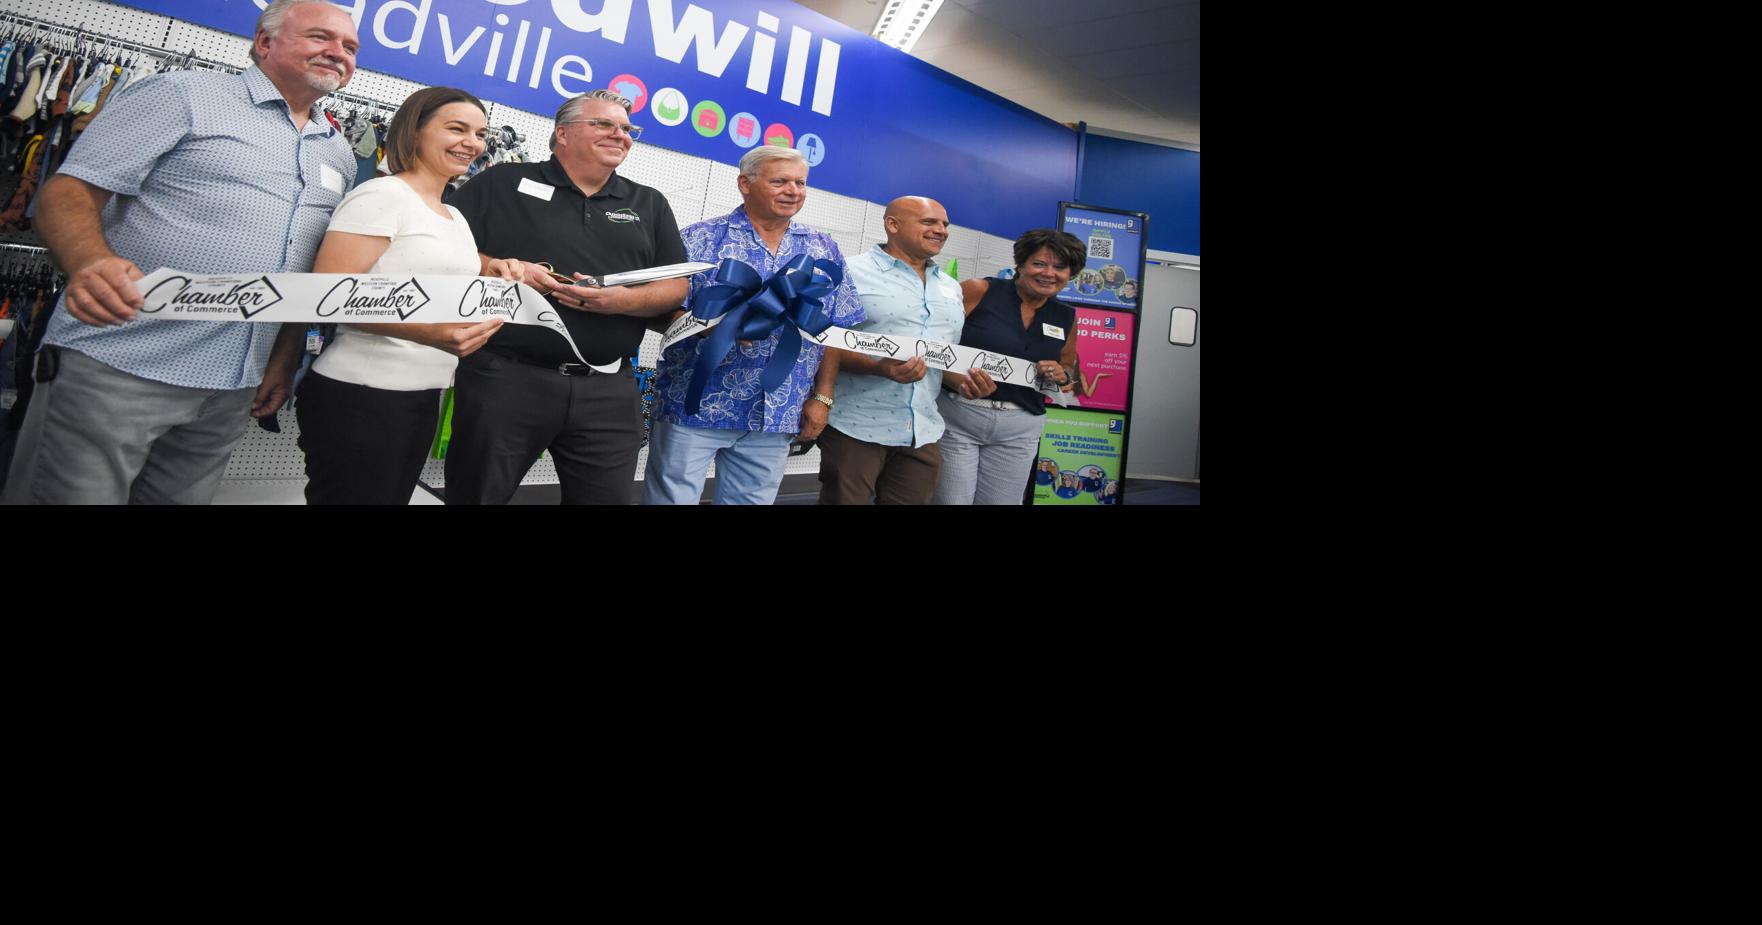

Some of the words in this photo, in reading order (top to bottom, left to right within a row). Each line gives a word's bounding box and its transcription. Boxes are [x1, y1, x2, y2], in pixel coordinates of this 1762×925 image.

[1065, 216, 1092, 226] WE'RE
[1094, 220, 1126, 230] HIRING!
[140, 276, 264, 313] Chamber
[316, 277, 415, 317] Chamber
[459, 279, 515, 317] Chamber
[174, 305, 184, 313] of
[187, 305, 239, 314] Commerce
[345, 308, 353, 316] of
[355, 308, 396, 316] Commerce
[1077, 317, 1100, 327] JOIN
[844, 330, 893, 351] Chamber
[1091, 330, 1126, 341] PERKS
[1045, 433, 1071, 441] SKILLS
[1072, 435, 1108, 444] TRAINING
[1070, 442, 1115, 451] READINESS
